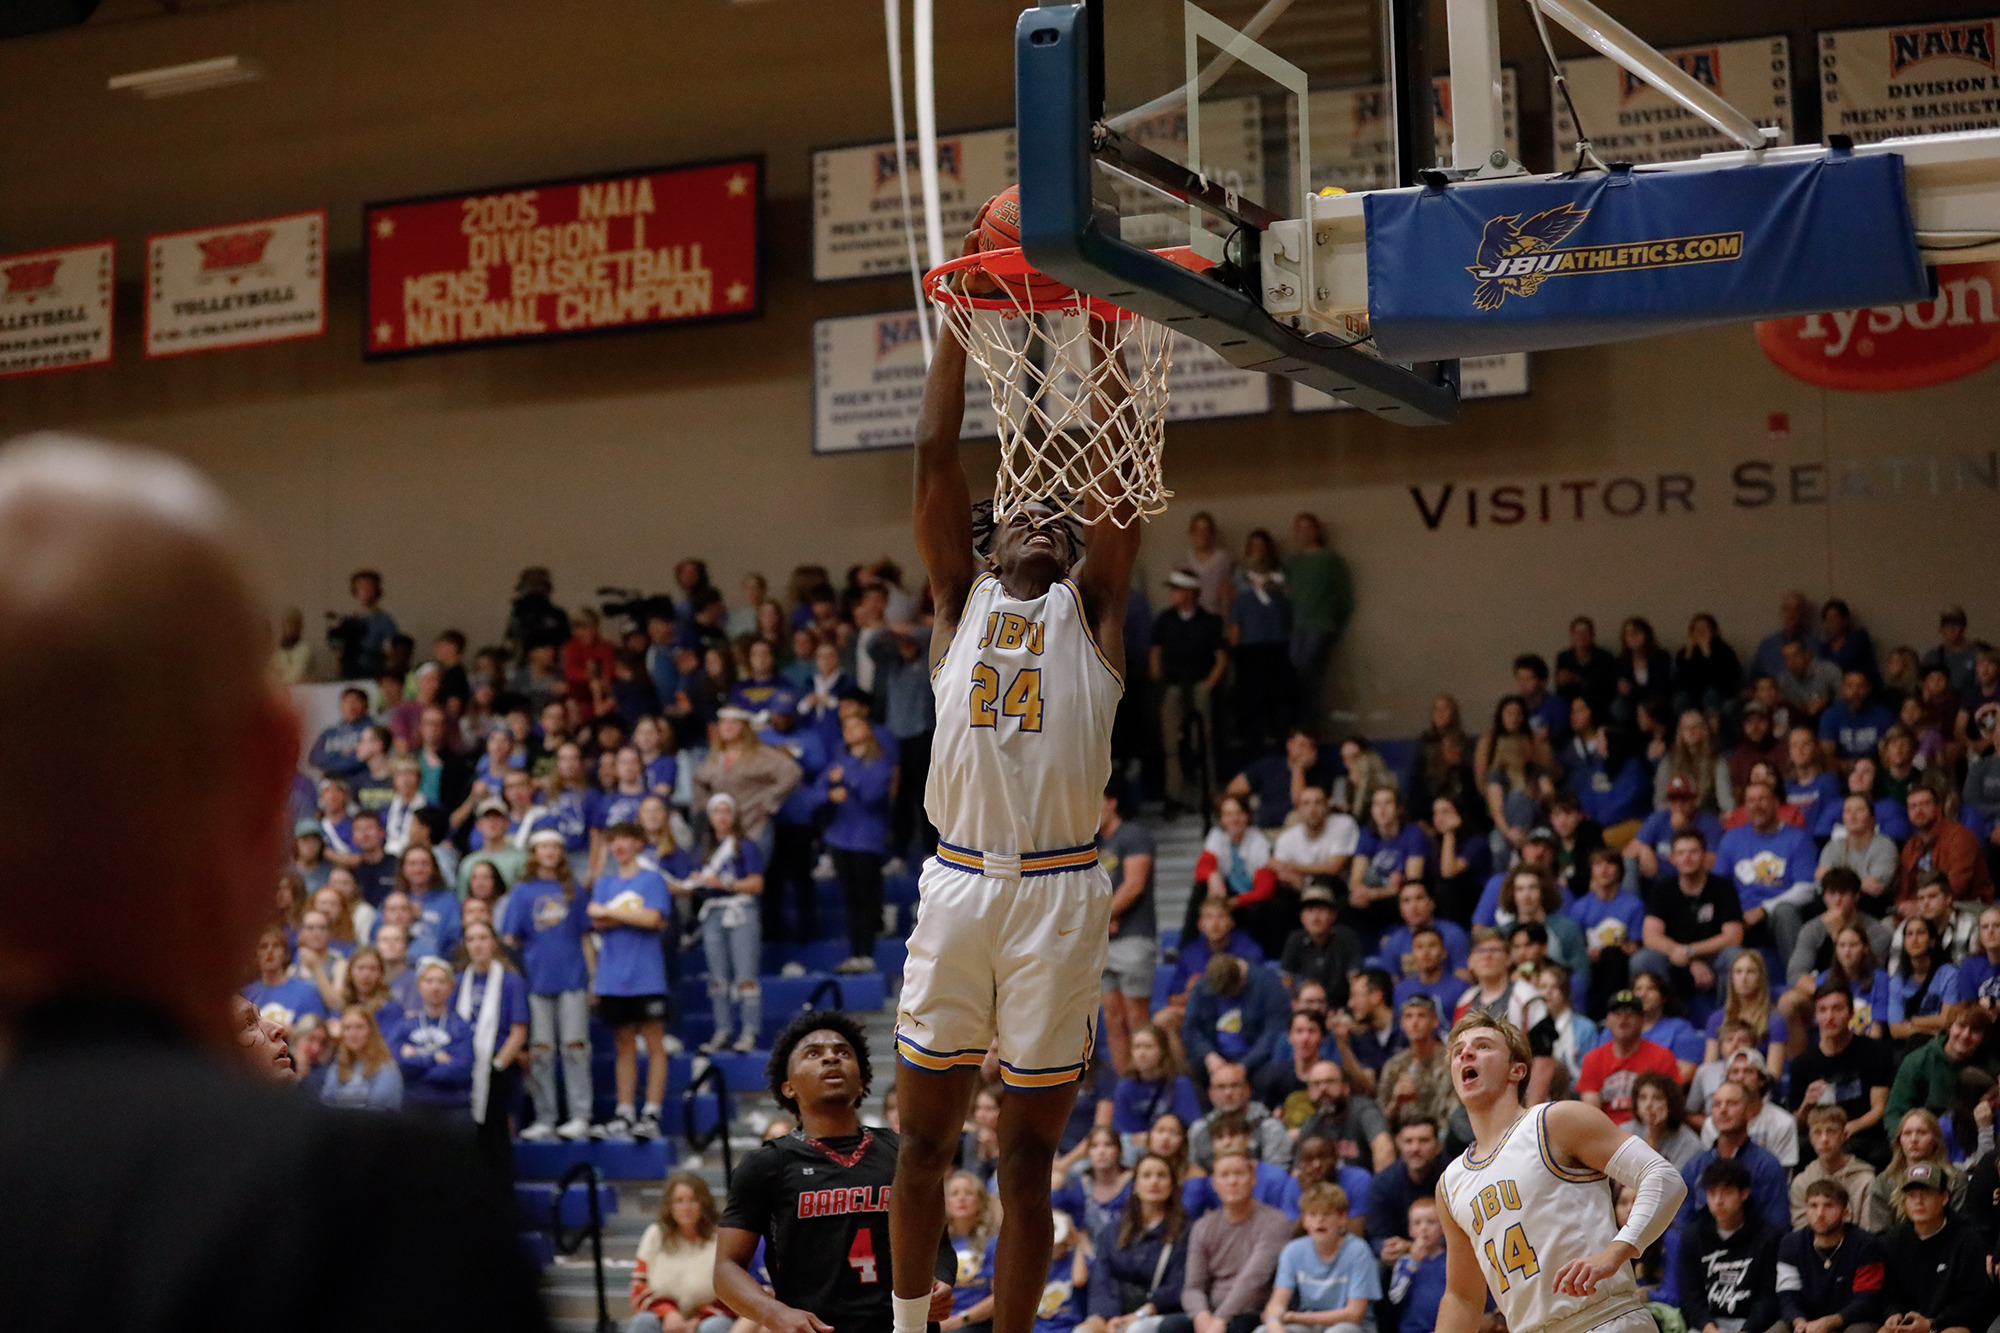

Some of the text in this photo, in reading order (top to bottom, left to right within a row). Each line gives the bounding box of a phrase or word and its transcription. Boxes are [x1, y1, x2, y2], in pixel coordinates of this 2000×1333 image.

[1894, 27, 1993, 68] NAIA
[1841, 105, 1906, 126] MEN'S
[1888, 77, 1986, 99] DIVISION
[461, 178, 655, 234] 2005 NAIA
[469, 219, 609, 270] DIVISION
[511, 242, 702, 299] BASKETBALL
[403, 268, 713, 347] NATIONAL CHAMPION
[1409, 472, 1697, 531] VISITOR
[978, 611, 1045, 657] JBU
[970, 661, 1045, 734] 24
[1469, 1179, 1523, 1236] JBU
[847, 1227, 879, 1284] 4
[1484, 1222, 1541, 1295] 14
